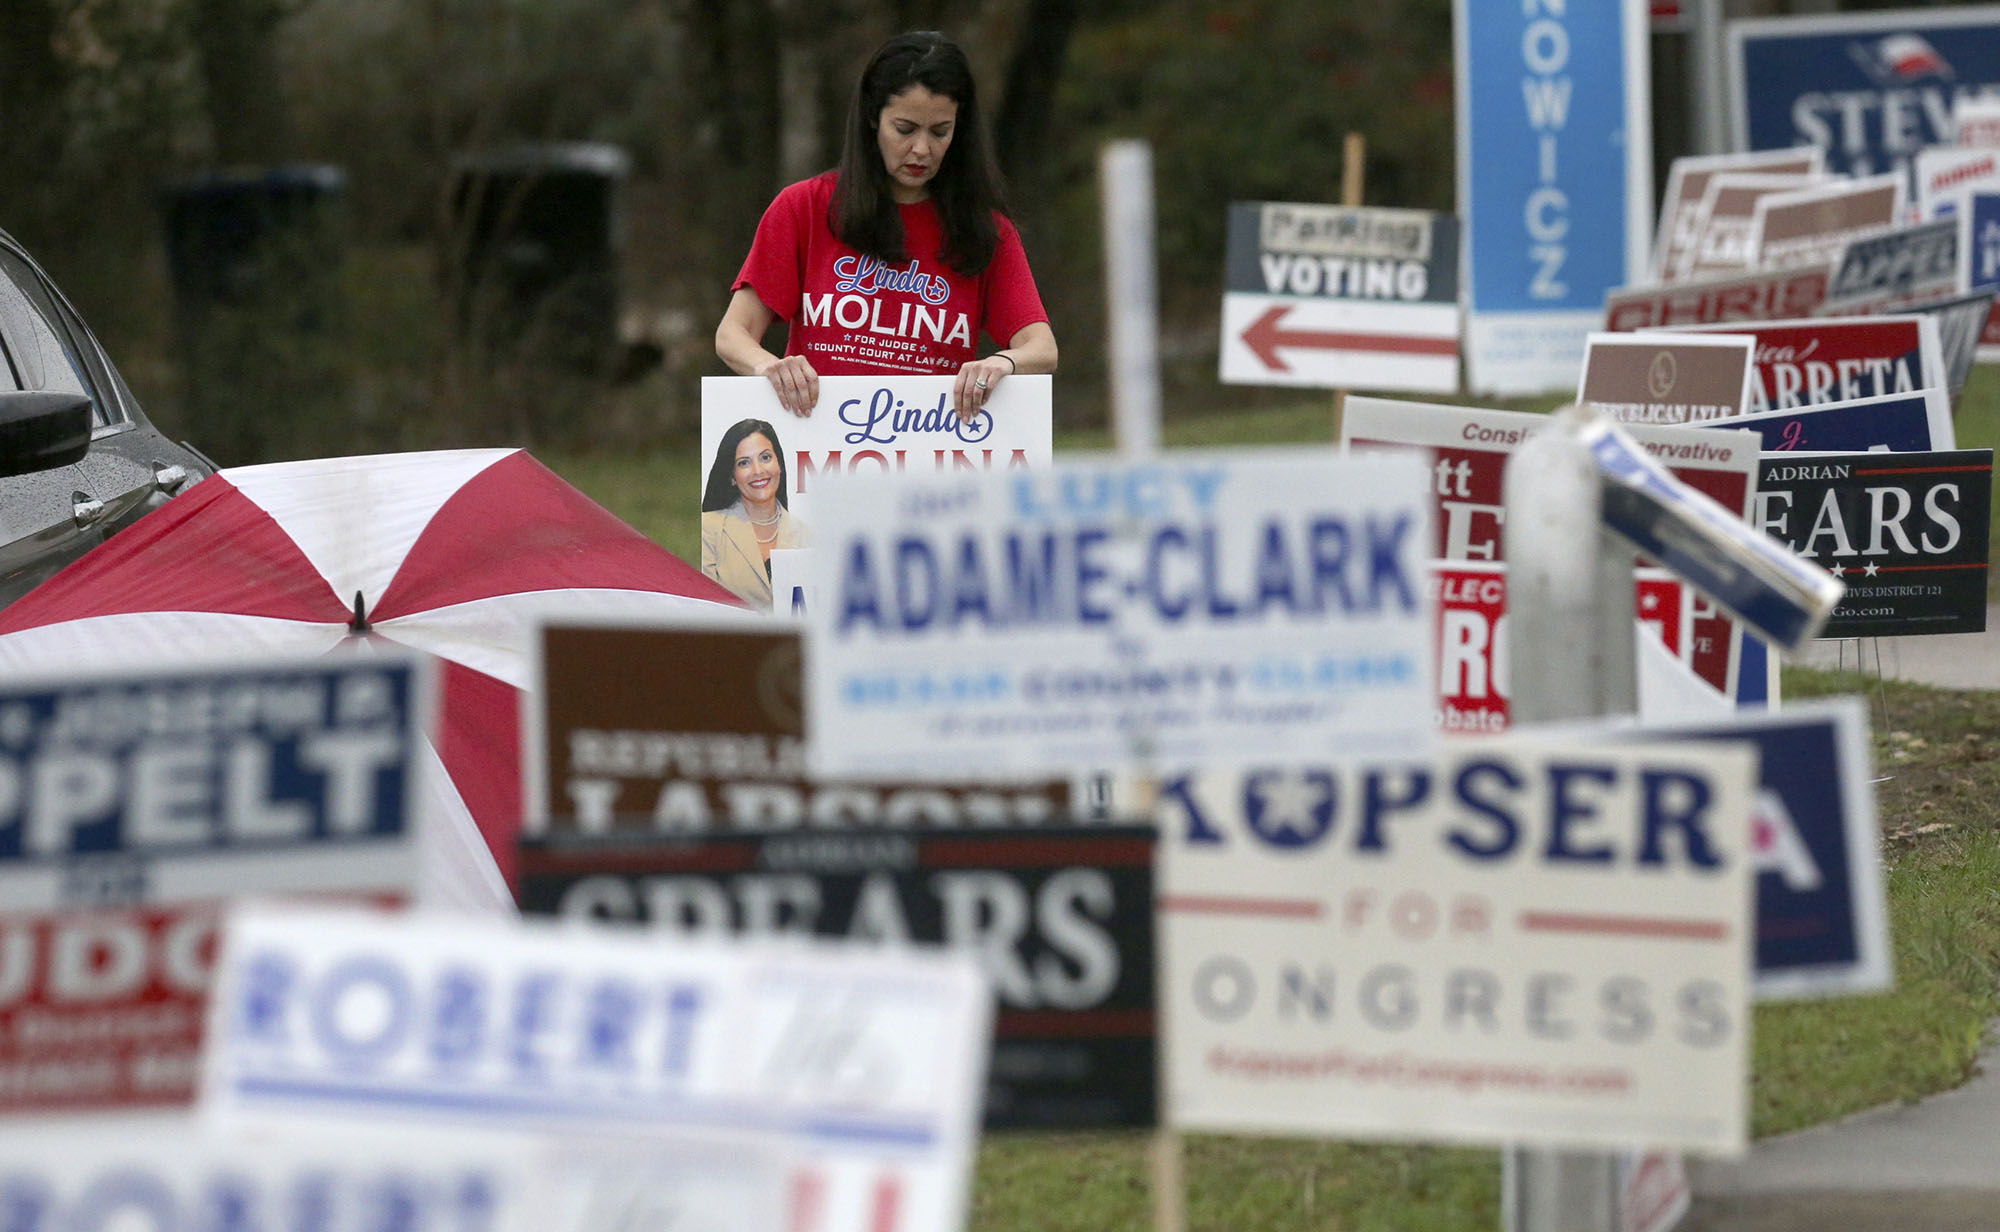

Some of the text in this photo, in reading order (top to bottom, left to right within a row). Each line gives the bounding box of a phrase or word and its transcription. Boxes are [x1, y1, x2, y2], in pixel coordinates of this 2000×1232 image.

[1793, 84, 1992, 151] STEV
[1268, 211, 1422, 251] Parking
[833, 253, 950, 305] Linda
[1260, 255, 1429, 301] VOTING
[802, 292, 971, 348] MOLINA
[854, 334, 917, 351] FOR JUDGE
[814, 342, 856, 354] COUNTY
[859, 346, 895, 360] COURT
[897, 352, 912, 362] AT
[1752, 355, 1914, 412] ARRETA
[838, 388, 993, 443] Linda
[1590, 402, 1687, 424] PUBLICAN
[1012, 464, 1230, 517] LUCY
[1766, 464, 1850, 481] ADRIAN
[1755, 483, 1961, 557] EARS
[837, 510, 1419, 636] ADAME-CLARK
[1876, 585, 1924, 598] DISTRICT
[1926, 585, 1942, 596] 121
[0, 730, 400, 855] PELT
[1341, 888, 1496, 941] FOR
[1190, 955, 1734, 1049] ONGRESS
